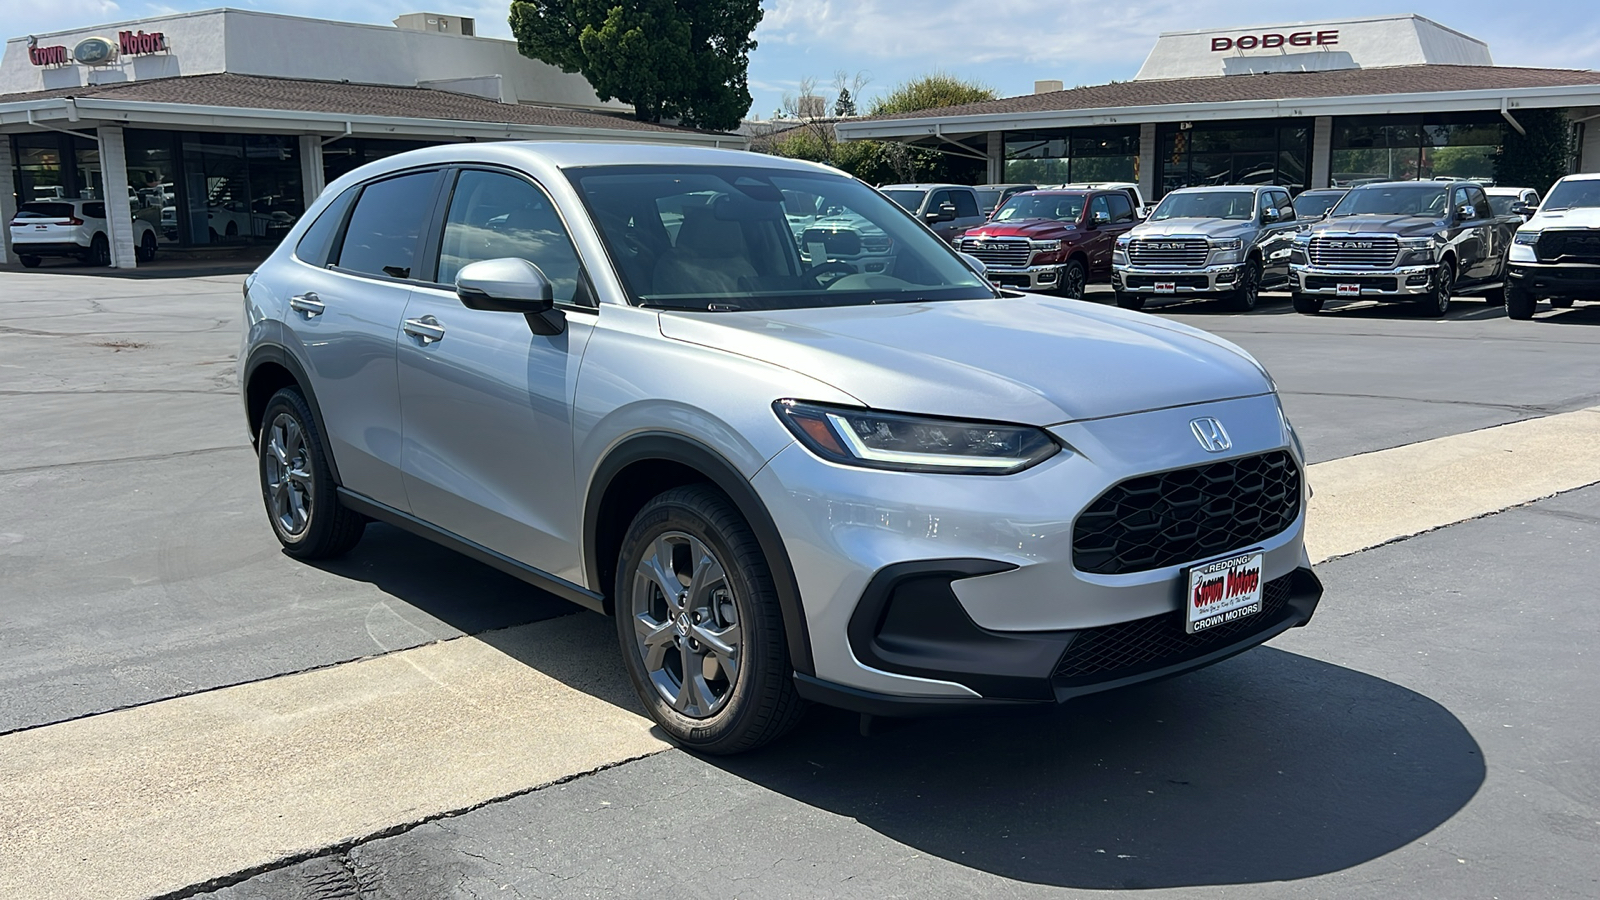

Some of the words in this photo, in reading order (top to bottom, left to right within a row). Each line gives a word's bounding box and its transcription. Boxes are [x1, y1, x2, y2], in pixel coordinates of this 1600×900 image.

[28, 45, 67, 66] Crown
[118, 31, 164, 55] Motors
[1211, 30, 1339, 51] DODGE
[1330, 241, 1373, 249] RAM
[1209, 556, 1248, 573] REDDING
[1194, 575, 1225, 608] Crown
[1225, 566, 1260, 599] Motors
[1193, 614, 1224, 631] CROWN
[1225, 604, 1258, 621] MOTORS
